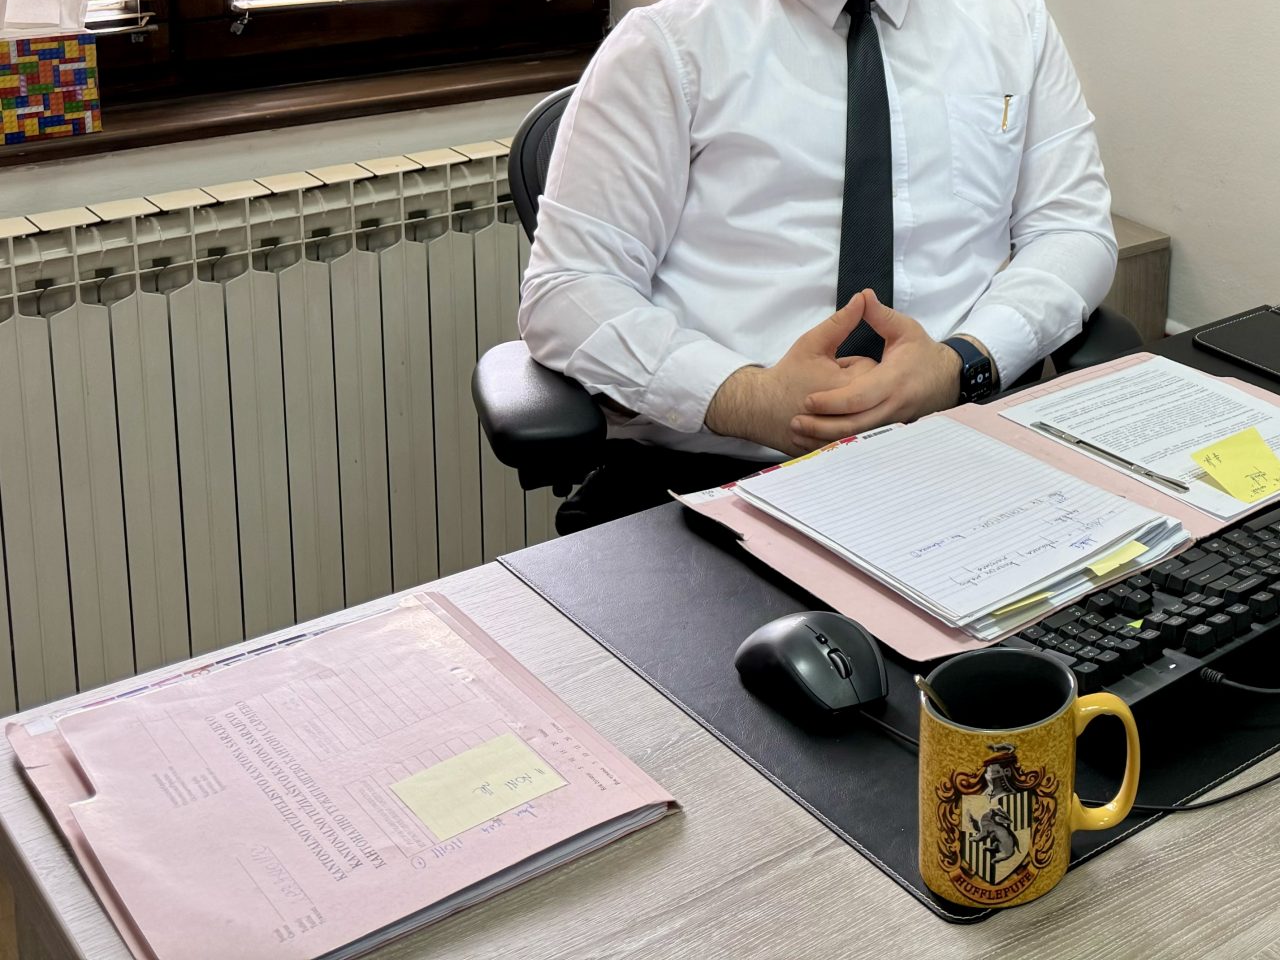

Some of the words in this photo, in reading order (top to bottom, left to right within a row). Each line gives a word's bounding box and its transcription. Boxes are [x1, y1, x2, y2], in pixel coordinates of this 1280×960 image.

[300, 830, 348, 882] KANTONALNO
[314, 818, 363, 870] KANTONALNO
[957, 872, 1031, 900] HUFFLEPUFF
